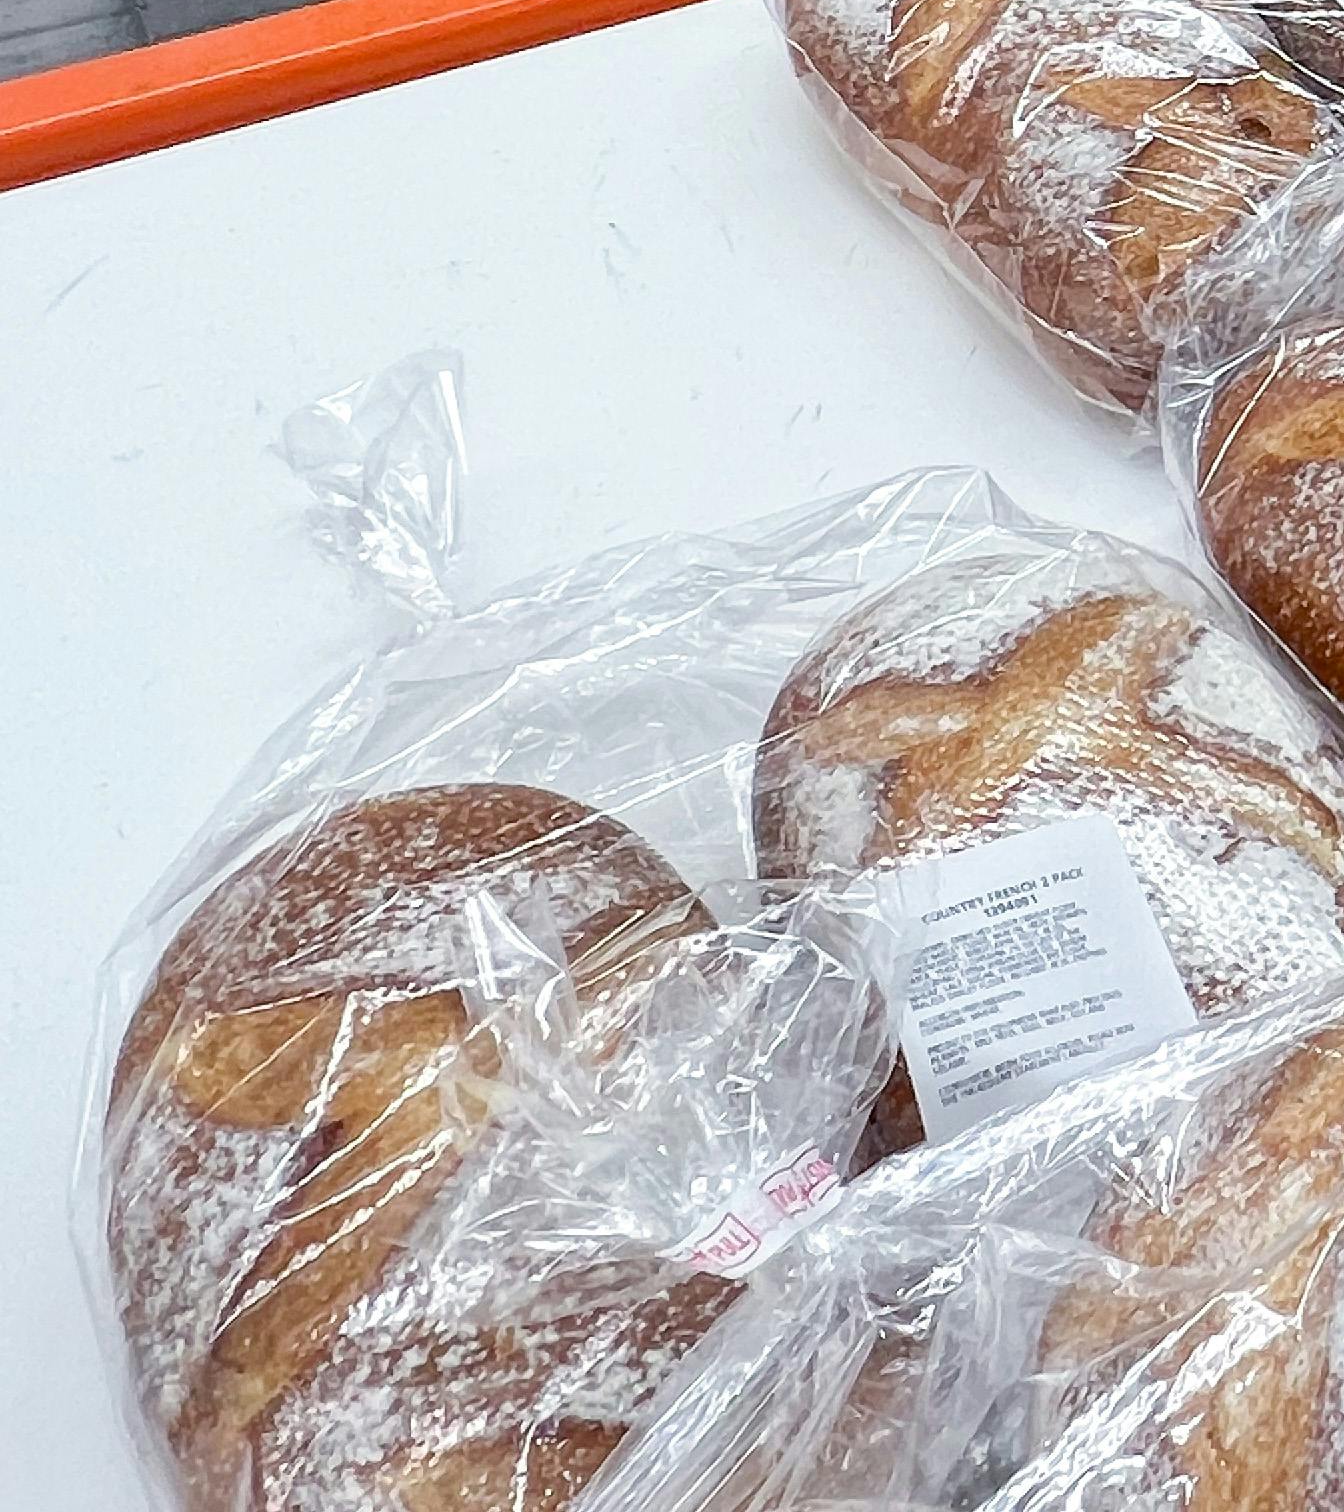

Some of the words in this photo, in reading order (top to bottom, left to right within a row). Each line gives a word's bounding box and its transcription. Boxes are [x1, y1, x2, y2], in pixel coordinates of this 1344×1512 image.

[987, 881, 1037, 903] FRENCH
[1040, 876, 1049, 887] 2
[1051, 867, 1083, 884] PACK
